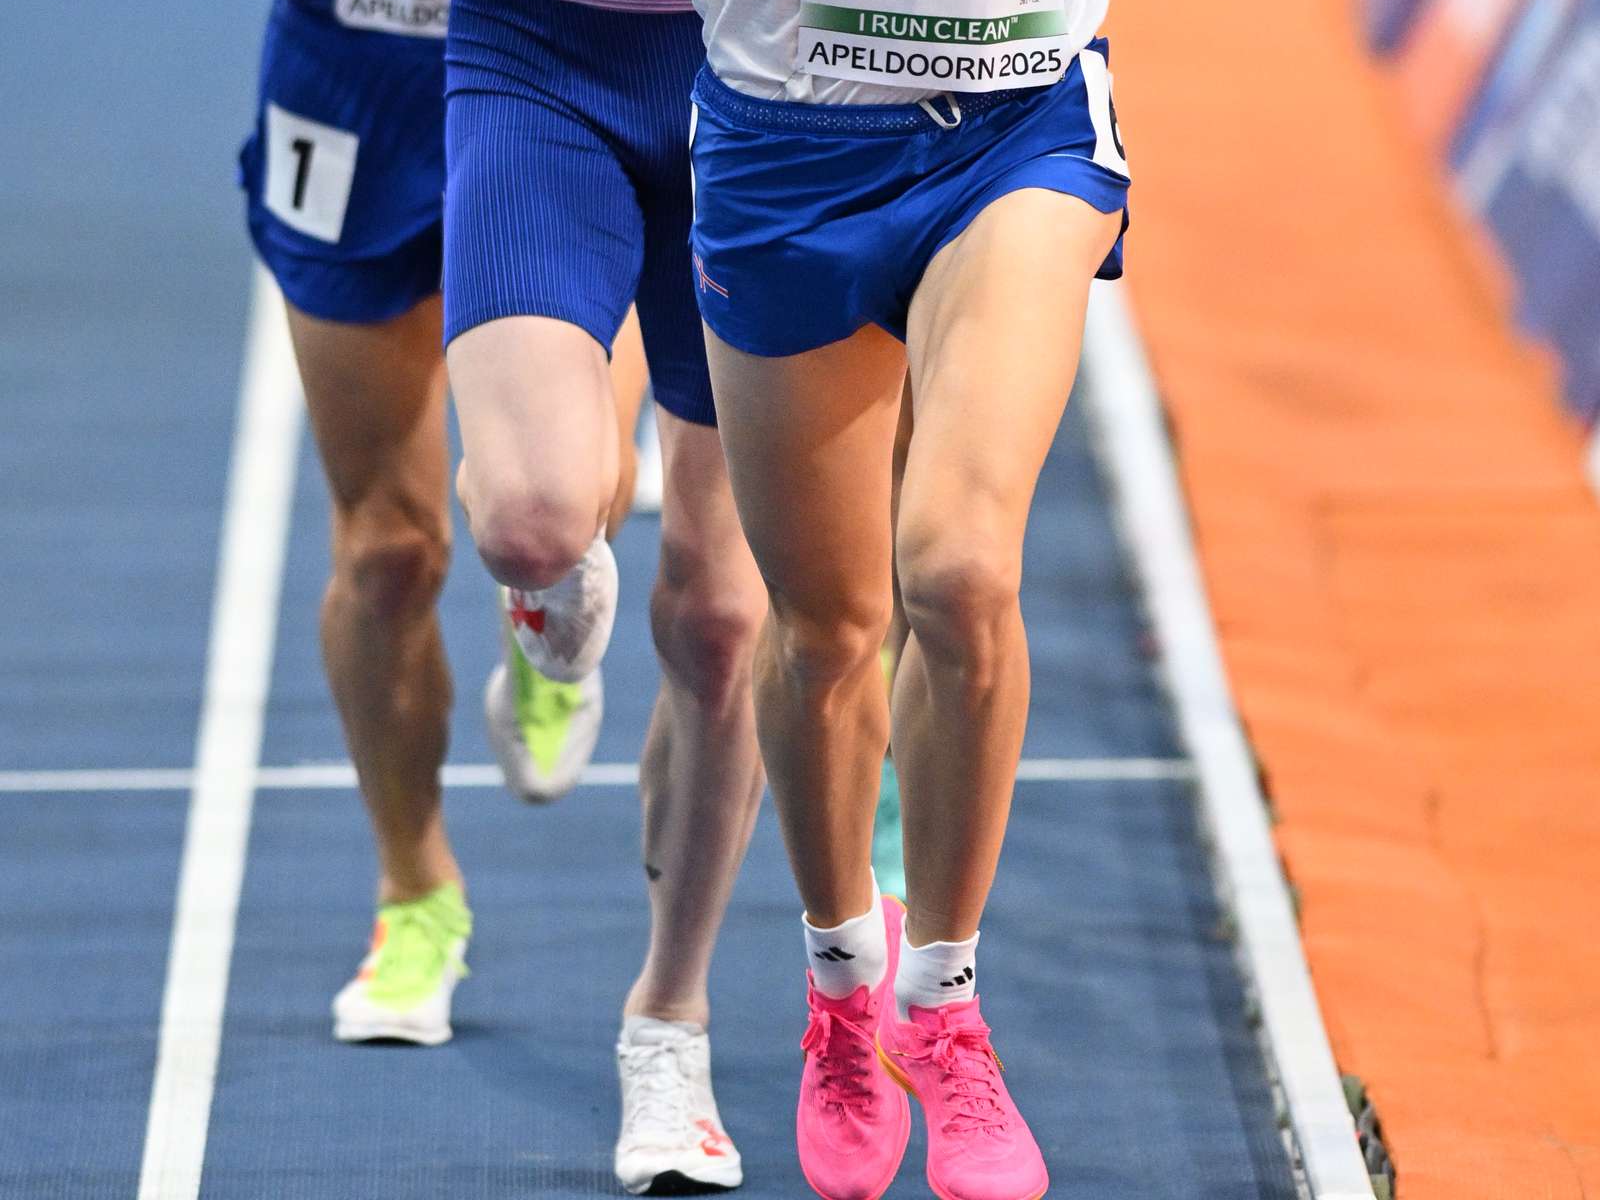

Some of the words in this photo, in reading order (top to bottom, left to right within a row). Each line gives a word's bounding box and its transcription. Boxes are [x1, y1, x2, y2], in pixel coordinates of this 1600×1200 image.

[858, 13, 865, 32] I
[871, 14, 928, 39] RUN
[808, 42, 995, 80] APELDOORN
[999, 49, 1062, 77] 2025
[291, 137, 315, 211] 1
